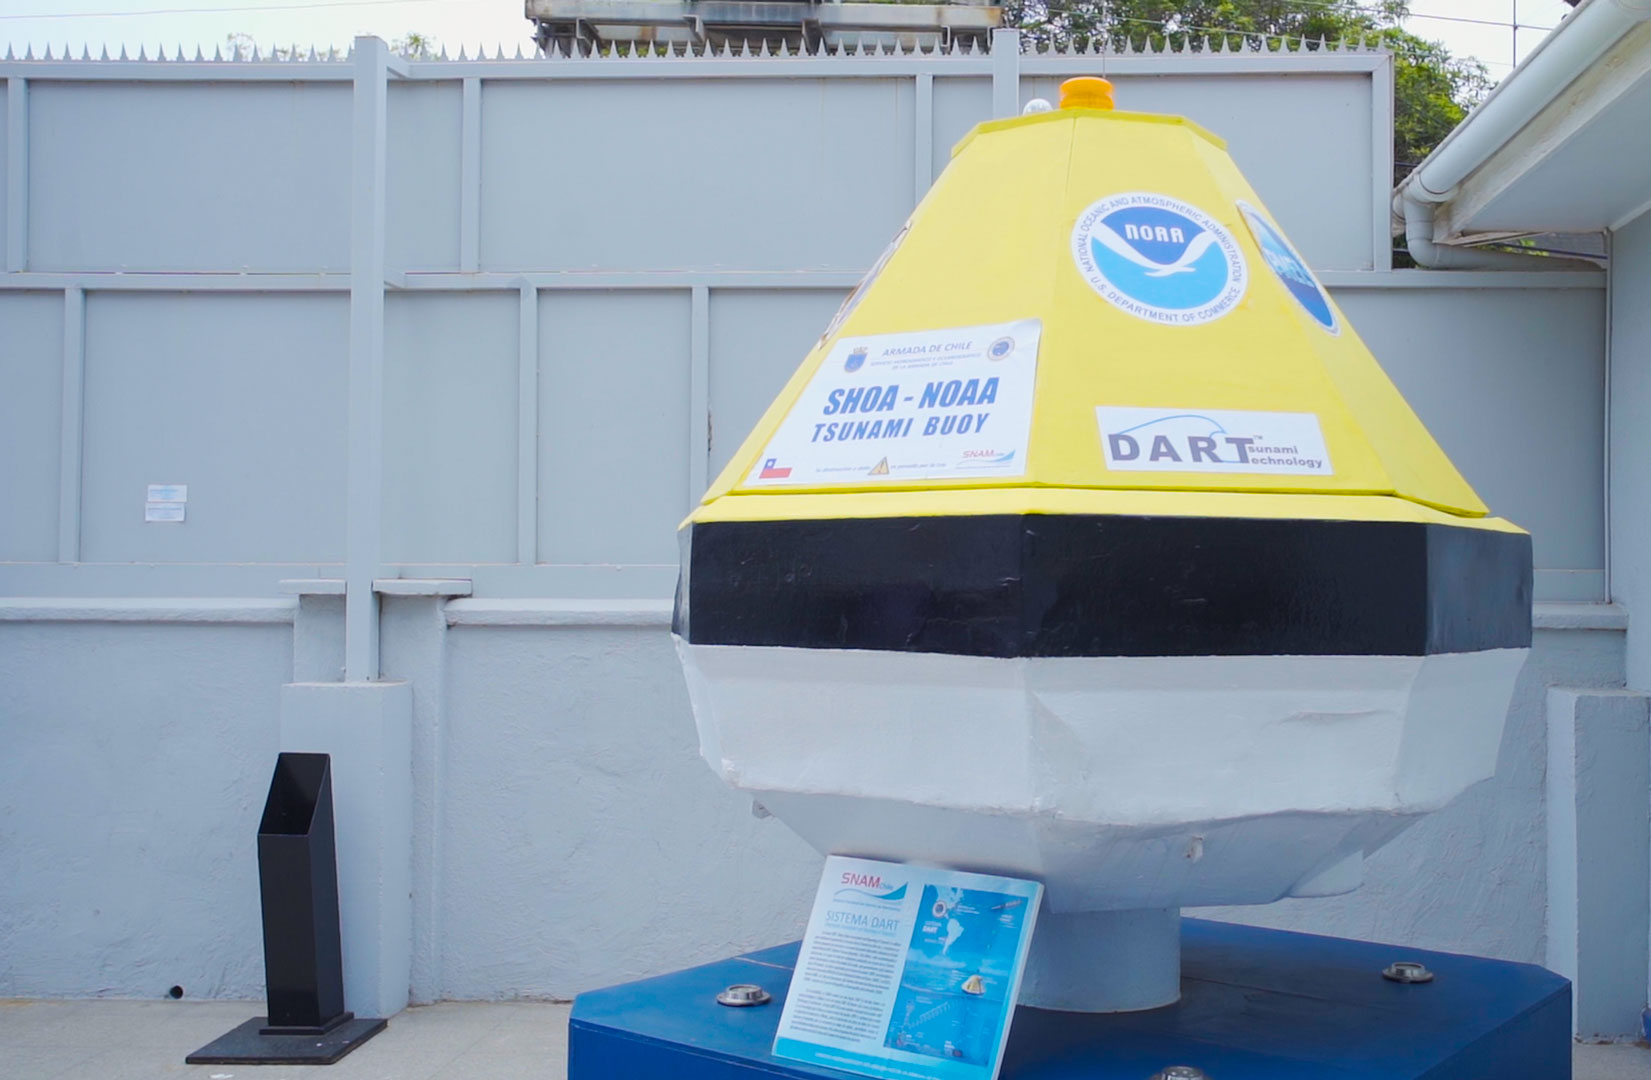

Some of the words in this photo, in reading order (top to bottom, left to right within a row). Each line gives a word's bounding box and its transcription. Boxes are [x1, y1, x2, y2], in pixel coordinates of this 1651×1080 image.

[1080, 203, 1110, 232] OCEANIC
[1108, 196, 1130, 210] AND
[1130, 196, 1203, 222] ATMOSPHERIC
[1124, 223, 1185, 244] NOAA
[1077, 233, 1094, 273] NATIONAL
[1201, 219, 1243, 283] ADMINISTRATION
[1090, 275, 1107, 294] U.S.
[1107, 291, 1179, 323] DEPARTMENT
[1182, 312, 1196, 323] OF
[1198, 286, 1241, 321] COMMERCE
[882, 345, 927, 356] ARMADA
[928, 343, 943, 353] DE
[944, 341, 973, 352] CHILE
[823, 384, 900, 416] SHOA
[918, 377, 1000, 409] NOAA
[811, 418, 914, 443] TSUNAMI
[922, 412, 990, 437] BUOY
[1107, 433, 1255, 464] DART
[841, 872, 881, 889] SNAM
[825, 910, 868, 926] SISTEMA
[871, 916, 900, 931] DART
